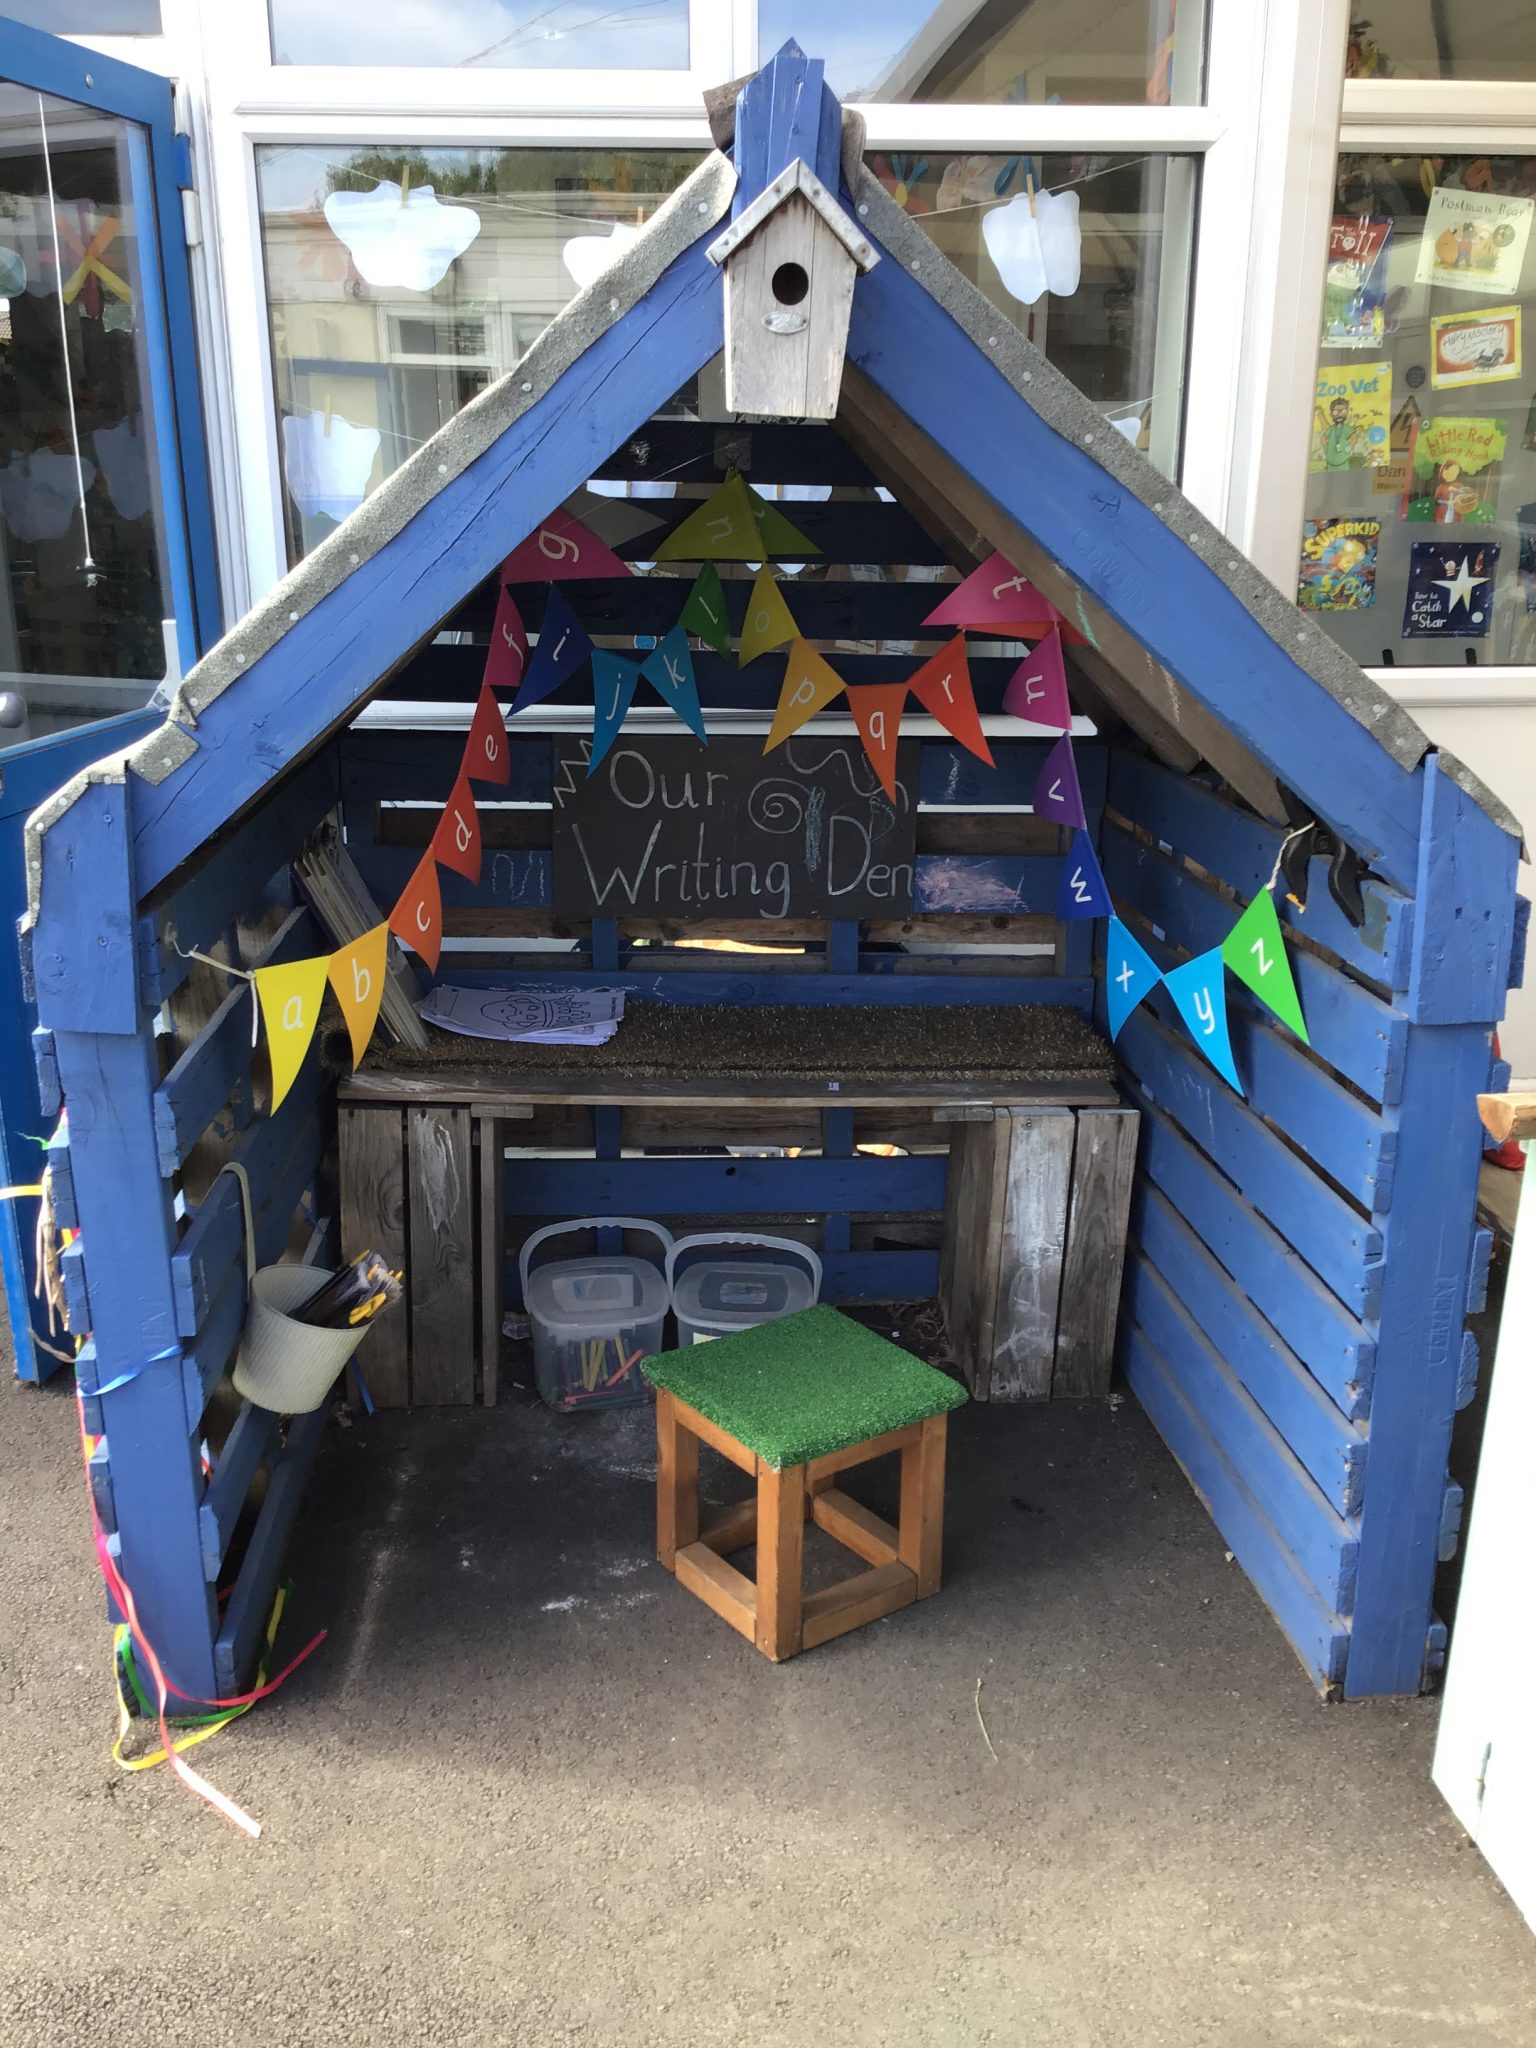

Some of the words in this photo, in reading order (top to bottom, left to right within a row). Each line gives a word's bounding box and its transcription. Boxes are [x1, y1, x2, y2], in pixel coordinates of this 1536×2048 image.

[1441, 197, 1493, 213] Postman
[1497, 203, 1525, 217] Bear
[1317, 381, 1347, 397] Zoo
[1350, 377, 1379, 394] Vet
[1426, 428, 1464, 449] Little
[1468, 427, 1494, 447] Red
[1430, 447, 1463, 460] Riding
[1465, 450, 1489, 461] Hood
[538, 529, 580, 564] g
[1304, 522, 1380, 560] SUPERKID
[992, 575, 1028, 599] t
[1414, 592, 1428, 600] How
[1430, 592, 1439, 600] to
[1412, 600, 1441, 612] Catch
[1418, 614, 1447, 628] Star
[503, 623, 524, 670] f
[552, 627, 571, 661] i
[663, 654, 686, 689] k
[606, 673, 622, 720] j
[788, 677, 816, 706] p
[942, 673, 955, 704] r
[1024, 673, 1046, 705] u
[485, 733, 498, 761] e
[868, 711, 887, 751] q
[610, 750, 729, 809] Our
[455, 809, 472, 853] d
[571, 819, 791, 919] Writing
[828, 815, 914, 898] Den
[416, 900, 430, 933] c
[352, 958, 371, 1002] b
[1115, 960, 1135, 993] x
[282, 995, 304, 1031] a
[1193, 987, 1217, 1035] y
